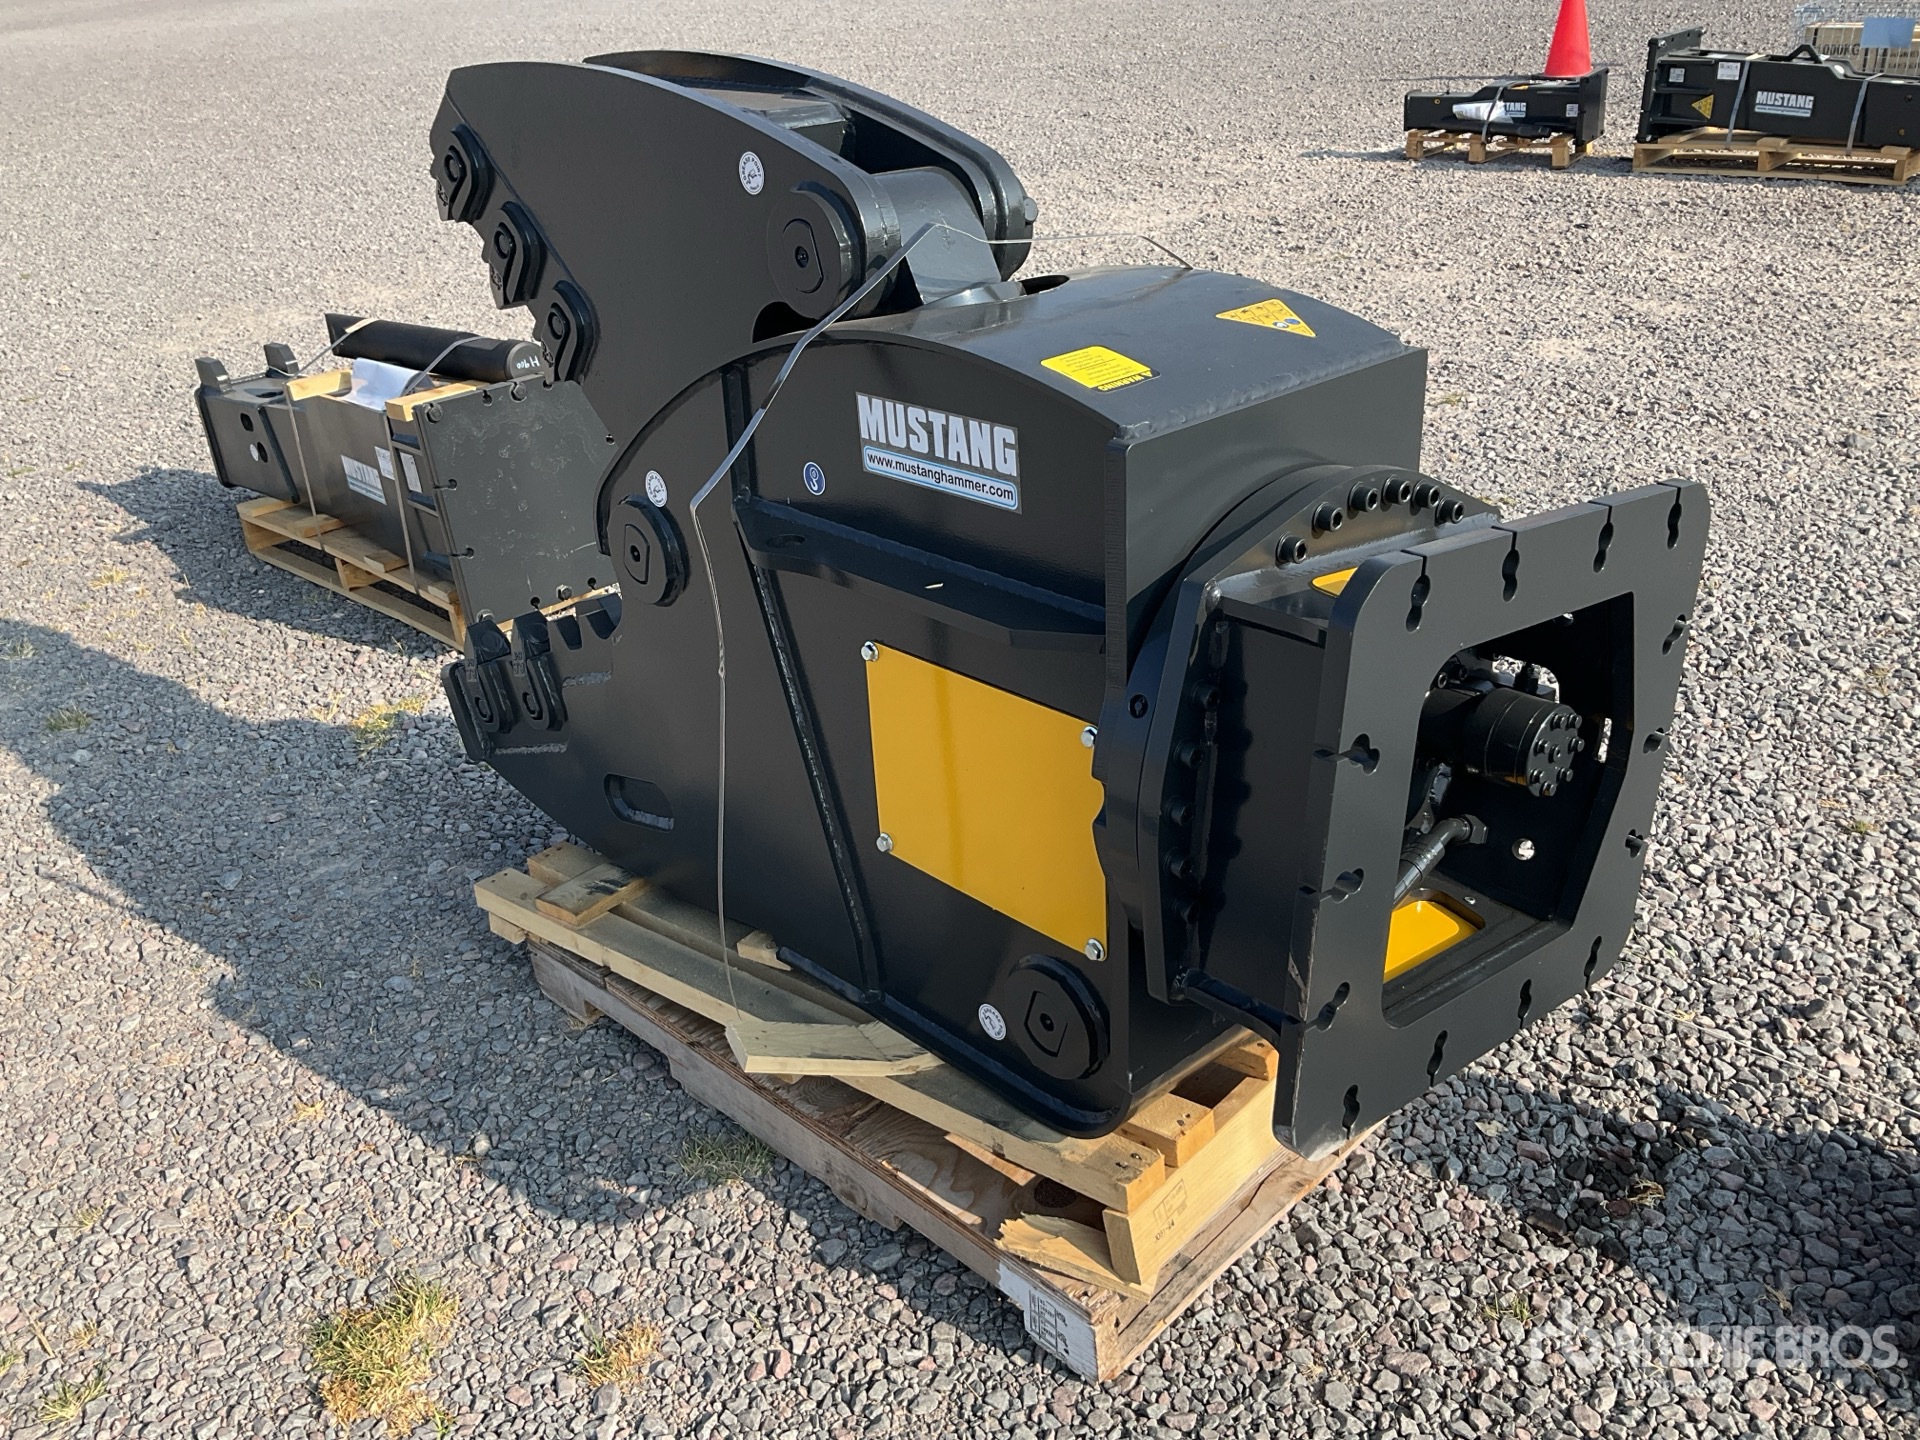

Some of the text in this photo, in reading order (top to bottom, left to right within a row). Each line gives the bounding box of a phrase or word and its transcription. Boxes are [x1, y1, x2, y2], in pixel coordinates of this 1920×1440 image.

[1506, 102, 1526, 111] TANG
[1756, 91, 1814, 109] MUSTANG
[1097, 374, 1145, 391] WARNING
[857, 394, 1017, 477] MUSTANG
[867, 452, 1014, 501] www.mustanghammer.com
